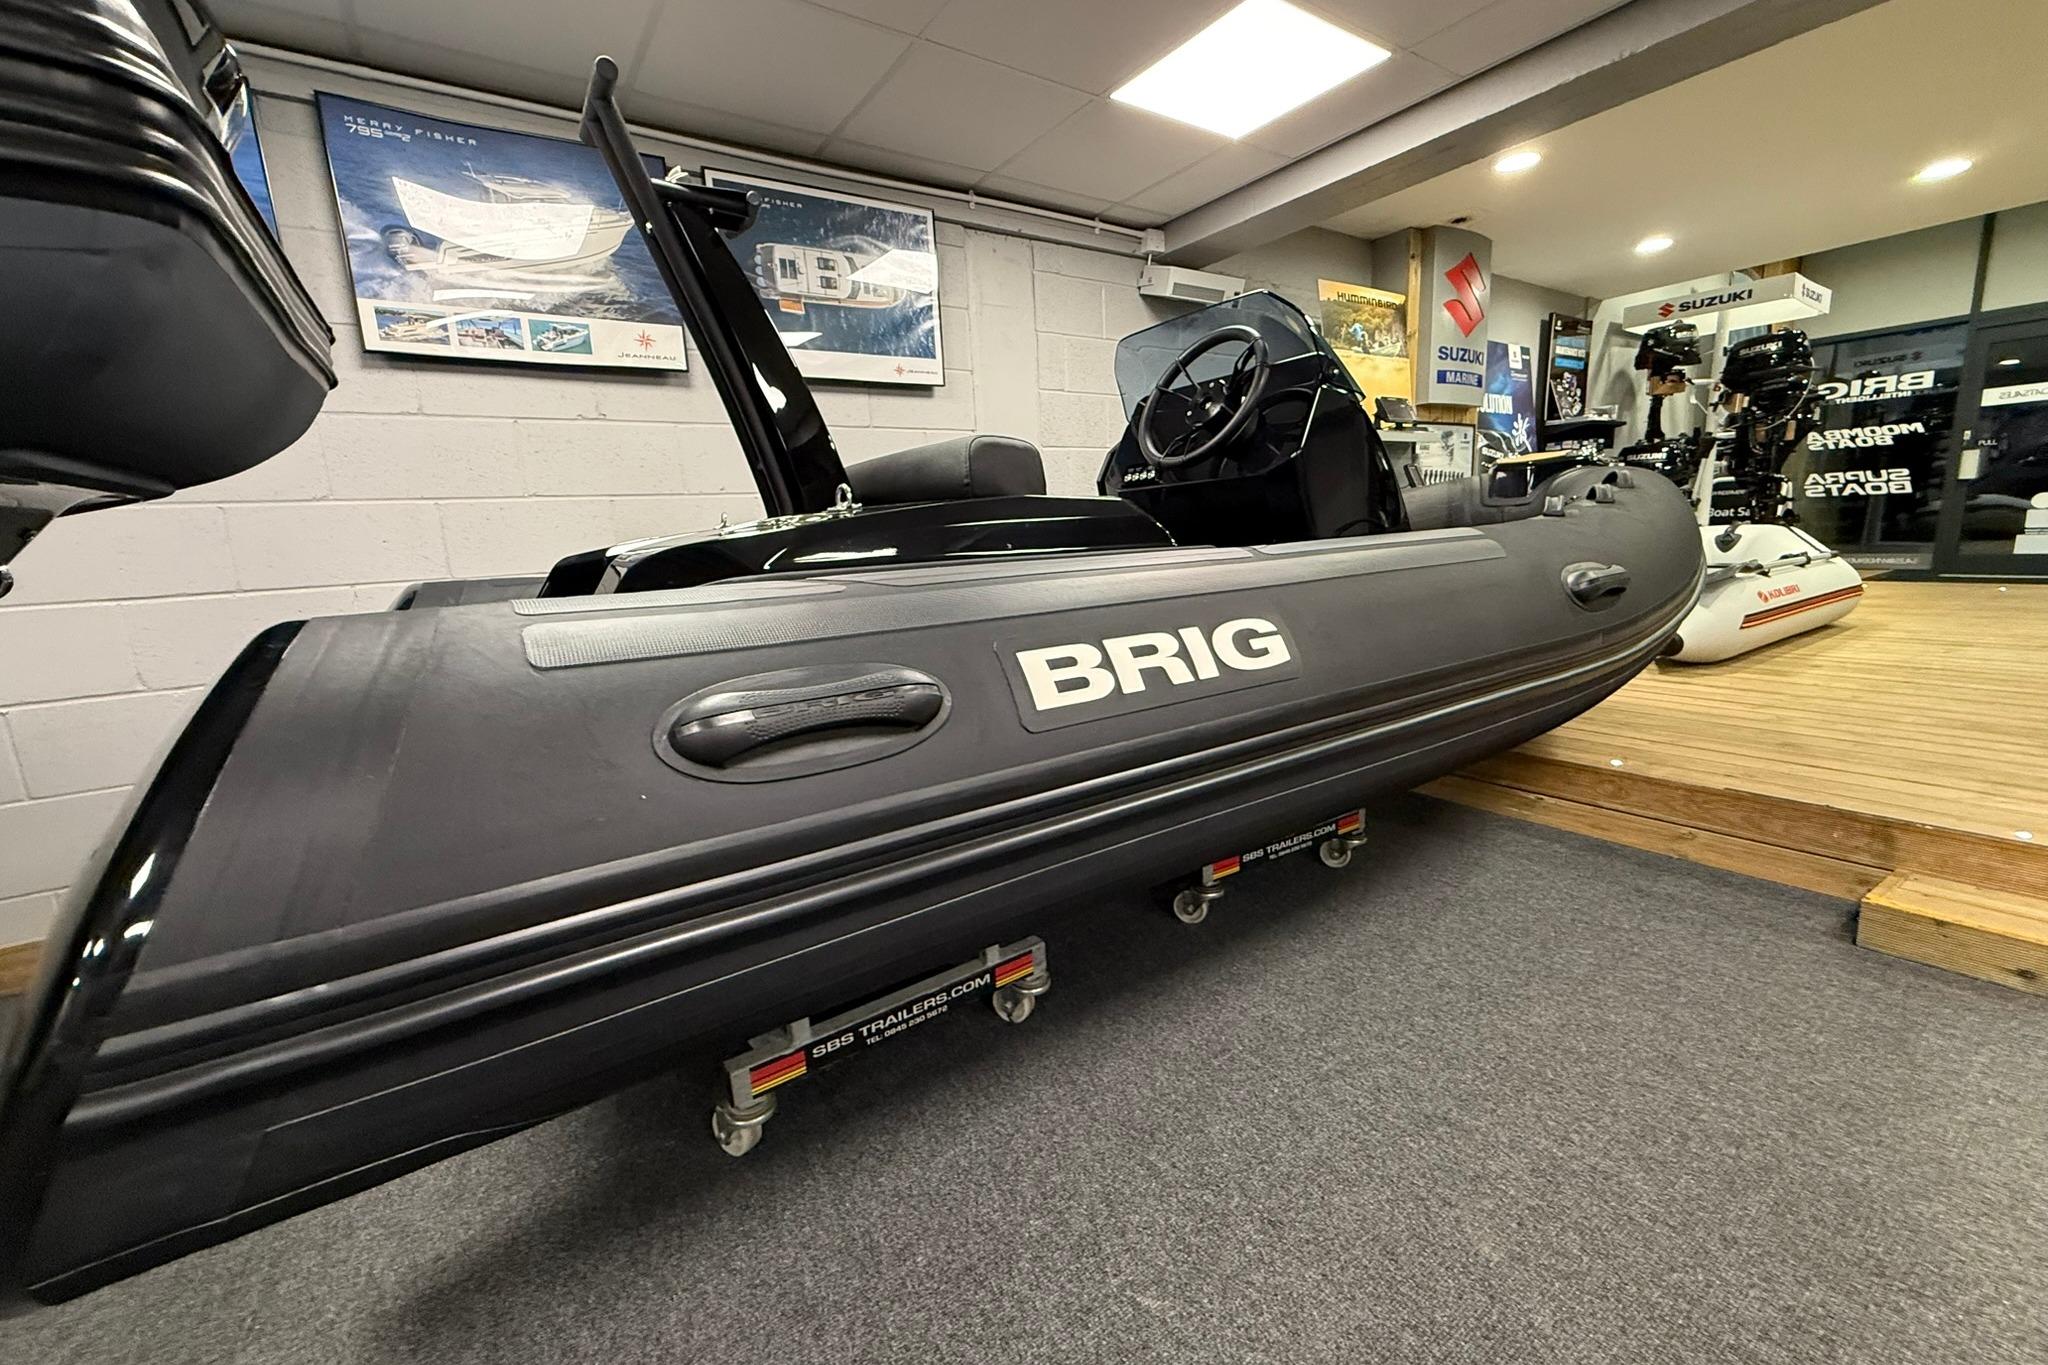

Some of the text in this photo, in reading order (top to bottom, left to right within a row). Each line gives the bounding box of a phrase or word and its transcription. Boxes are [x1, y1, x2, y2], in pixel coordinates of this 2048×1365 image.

[344, 114, 403, 132] MERRY
[414, 128, 477, 146] FISHER
[345, 123, 384, 139] 795
[1336, 291, 1398, 311] HUMMINBIRD
[1678, 288, 1753, 312] SUZUKI
[617, 351, 677, 361] JEANNEAU
[1438, 345, 1484, 366] SUZUKI
[1445, 371, 1479, 386] MARINE
[1626, 451, 1668, 461] SUZUKI
[1767, 584, 1801, 600] KOLIBRI
[1015, 618, 1291, 711] BRIG
[1242, 848, 1265, 863] SBS
[1266, 823, 1337, 854] TRAILERS.COM
[812, 973, 992, 1058] SBS TRAILERS.COM
[884, 1023, 908, 1037] 0845
[908, 1015, 926, 1027] 230
